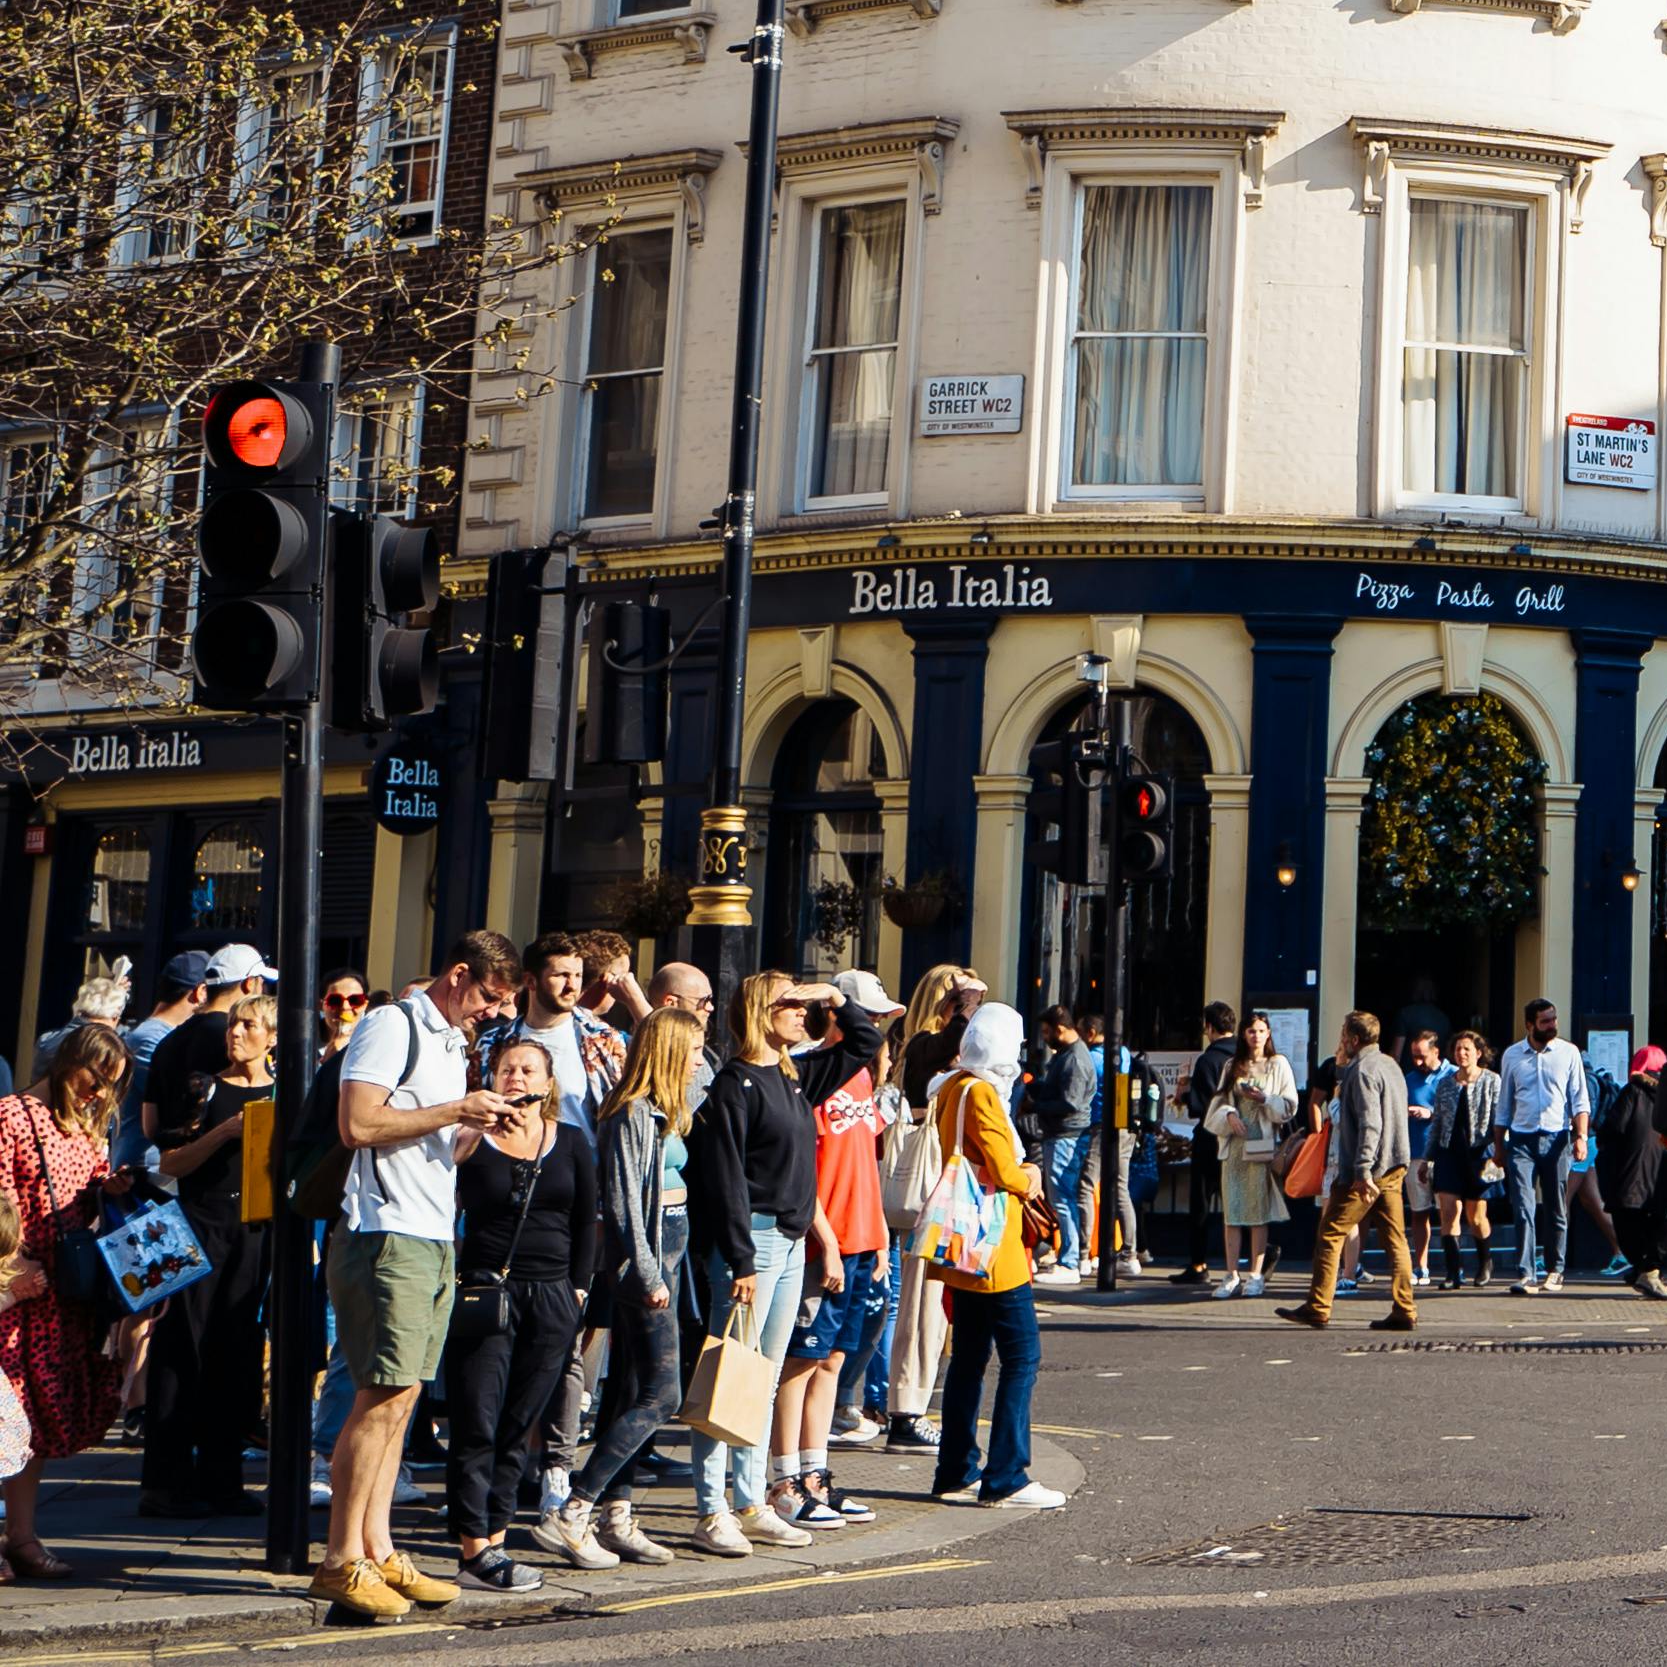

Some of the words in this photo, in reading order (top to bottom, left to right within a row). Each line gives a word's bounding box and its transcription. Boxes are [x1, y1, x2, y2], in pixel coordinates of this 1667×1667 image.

[929, 381, 988, 397] GARRICK
[928, 399, 977, 414] STREET
[982, 398, 1012, 413] WC2
[927, 423, 940, 431] CITY
[1577, 433, 1591, 446] ST
[1595, 435, 1648, 453] MARTIN'S
[1577, 450, 1605, 465] LANE
[1609, 453, 1633, 468] WC2
[849, 568, 938, 614] Bella
[947, 564, 1053, 608] Italia
[1356, 573, 1415, 610] Pizza
[1436, 581, 1495, 607] Pasta
[1515, 584, 1565, 615] Grill
[69, 737, 130, 773] Bella
[386, 758, 440, 786] Bella
[385, 791, 438, 818] Italia
